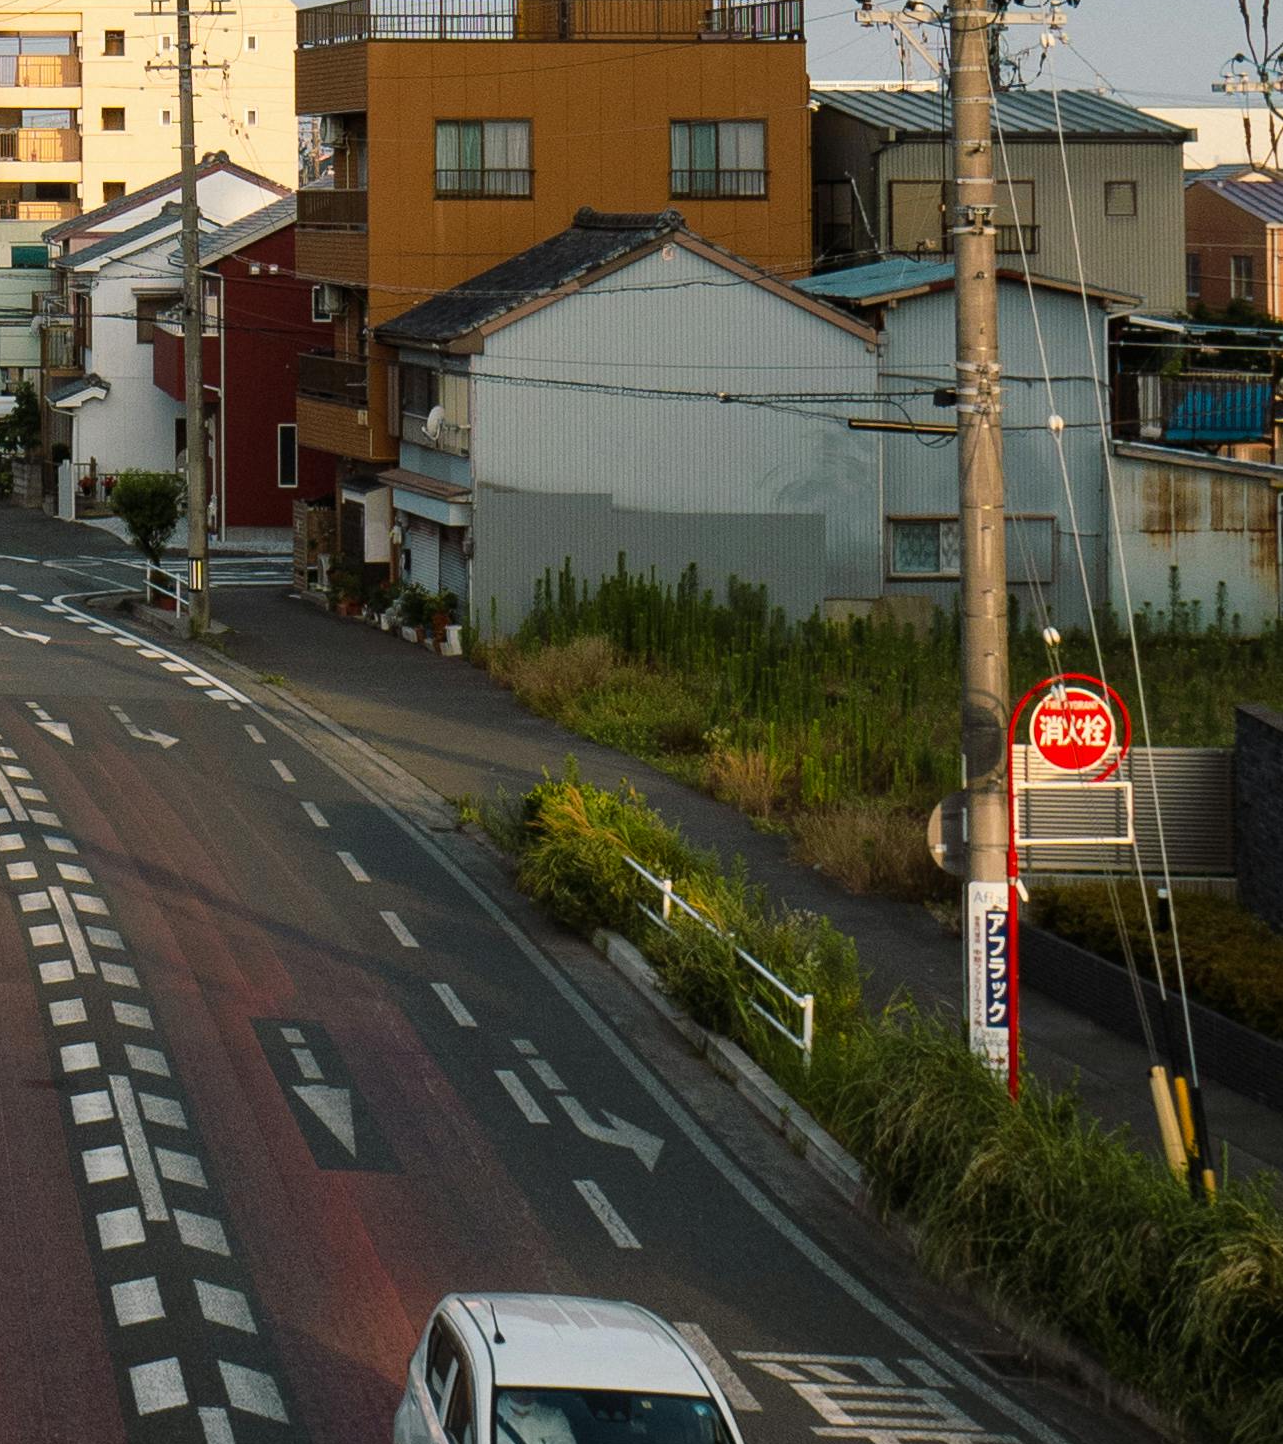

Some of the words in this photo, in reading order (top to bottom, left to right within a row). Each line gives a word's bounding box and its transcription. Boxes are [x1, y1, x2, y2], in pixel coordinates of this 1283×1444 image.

[1039, 714, 1107, 747] 消火栓
[987, 913, 1006, 1023] アフラック
